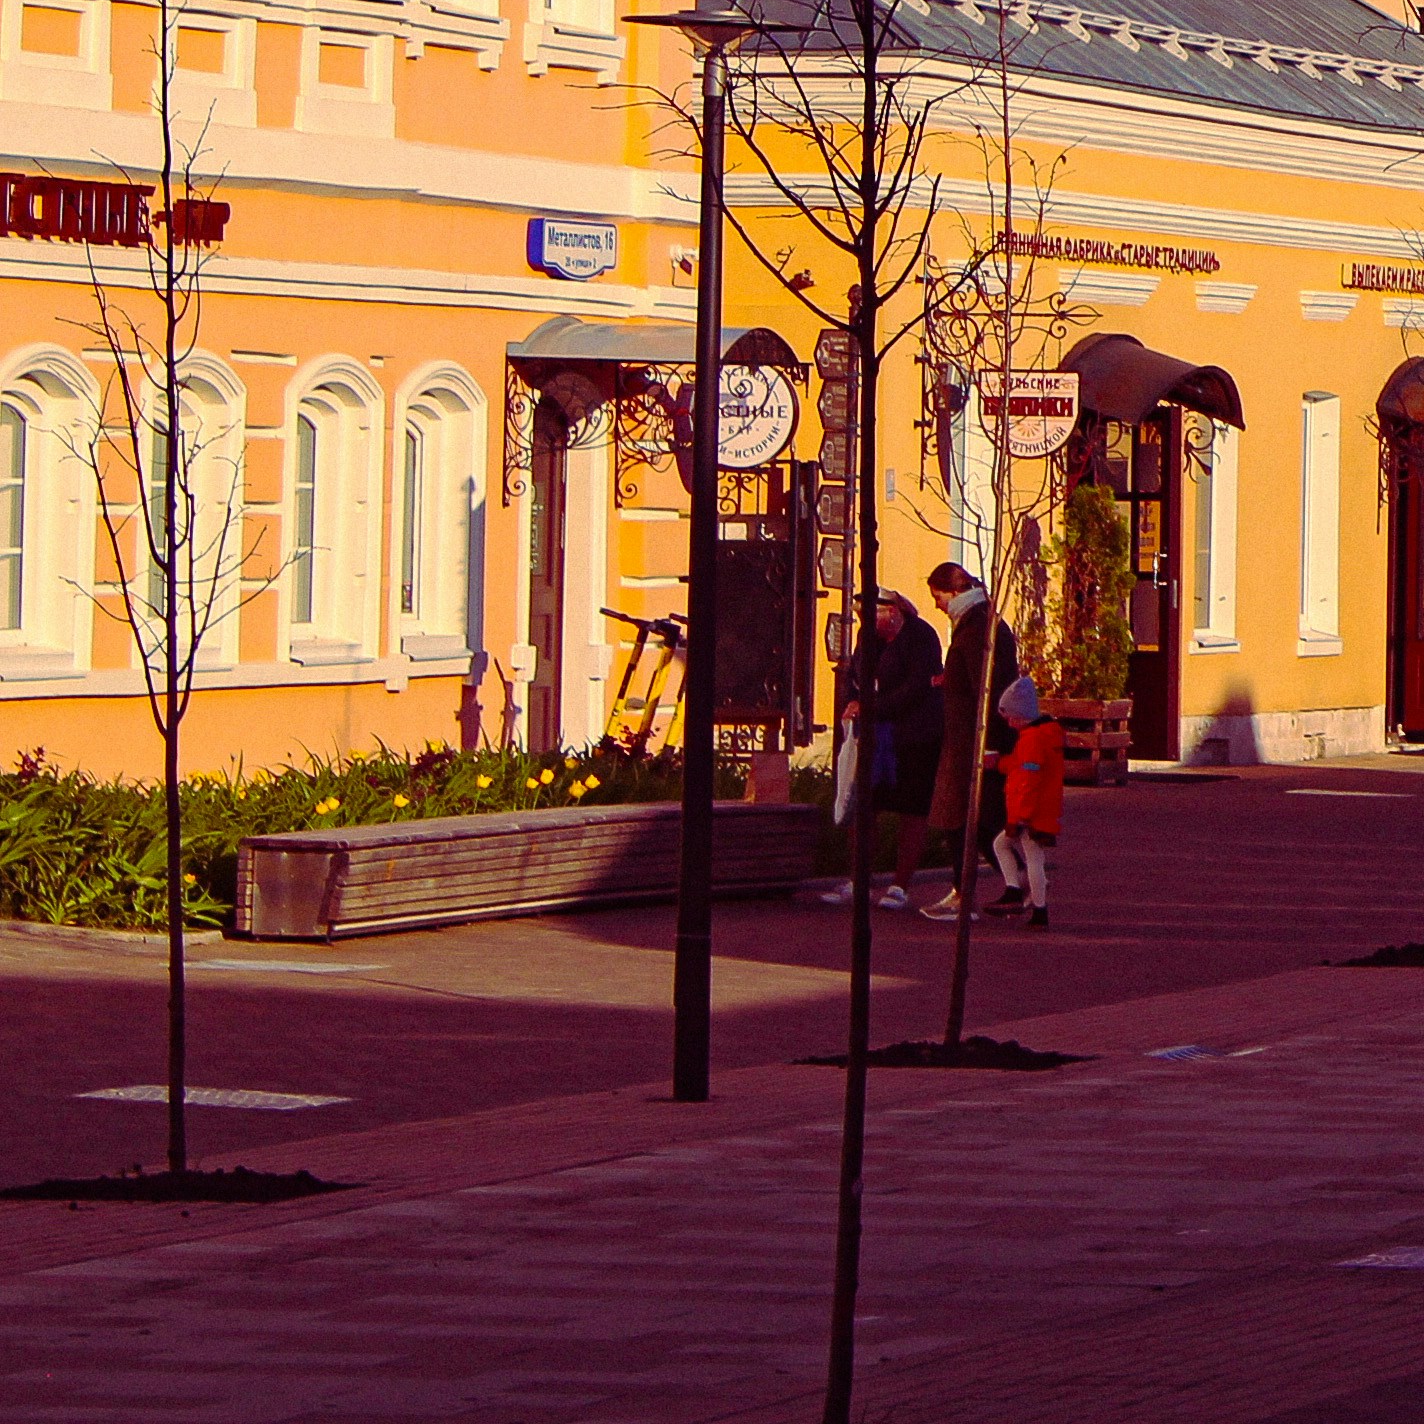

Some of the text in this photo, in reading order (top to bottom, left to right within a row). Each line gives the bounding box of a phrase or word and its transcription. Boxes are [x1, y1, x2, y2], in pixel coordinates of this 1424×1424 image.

[605, 231, 614, 251] 16
[1064, 237, 1112, 261] ФАБРИКА
[1001, 377, 1061, 390] УЛЬСКИЕ
[720, 405, 788, 419] СТНЫЕ
[728, 426, 753, 435] БАР
